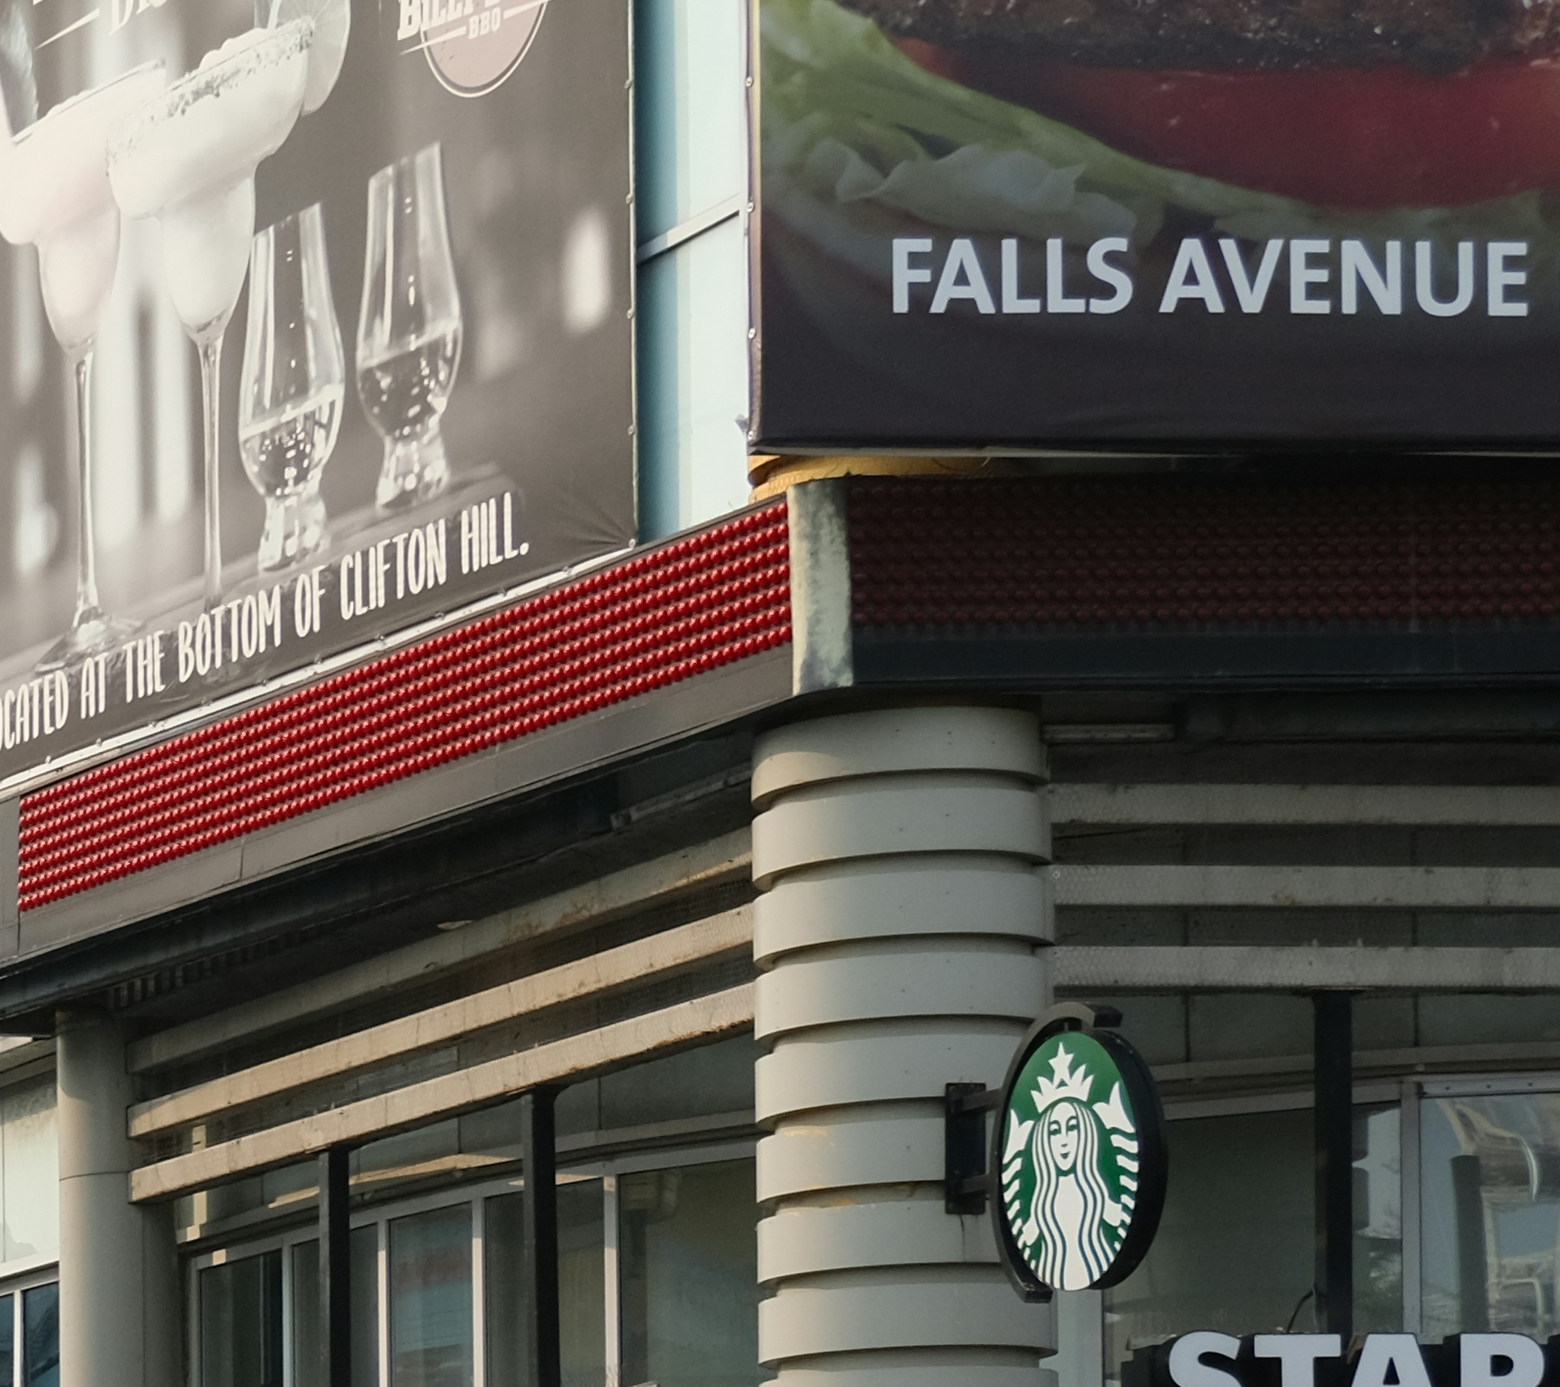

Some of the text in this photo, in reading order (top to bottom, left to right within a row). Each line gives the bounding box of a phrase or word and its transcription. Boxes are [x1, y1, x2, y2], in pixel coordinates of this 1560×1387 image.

[467, 10, 502, 39] BBQ
[892, 237, 1529, 317] FALLS AVENUE
[81, 654, 107, 718] AT
[123, 629, 164, 704] THE
[177, 591, 283, 684] BOTTOM
[293, 563, 327, 632] OF
[340, 518, 446, 623] CLIFTON
[460, 491, 530, 576] HILL.
